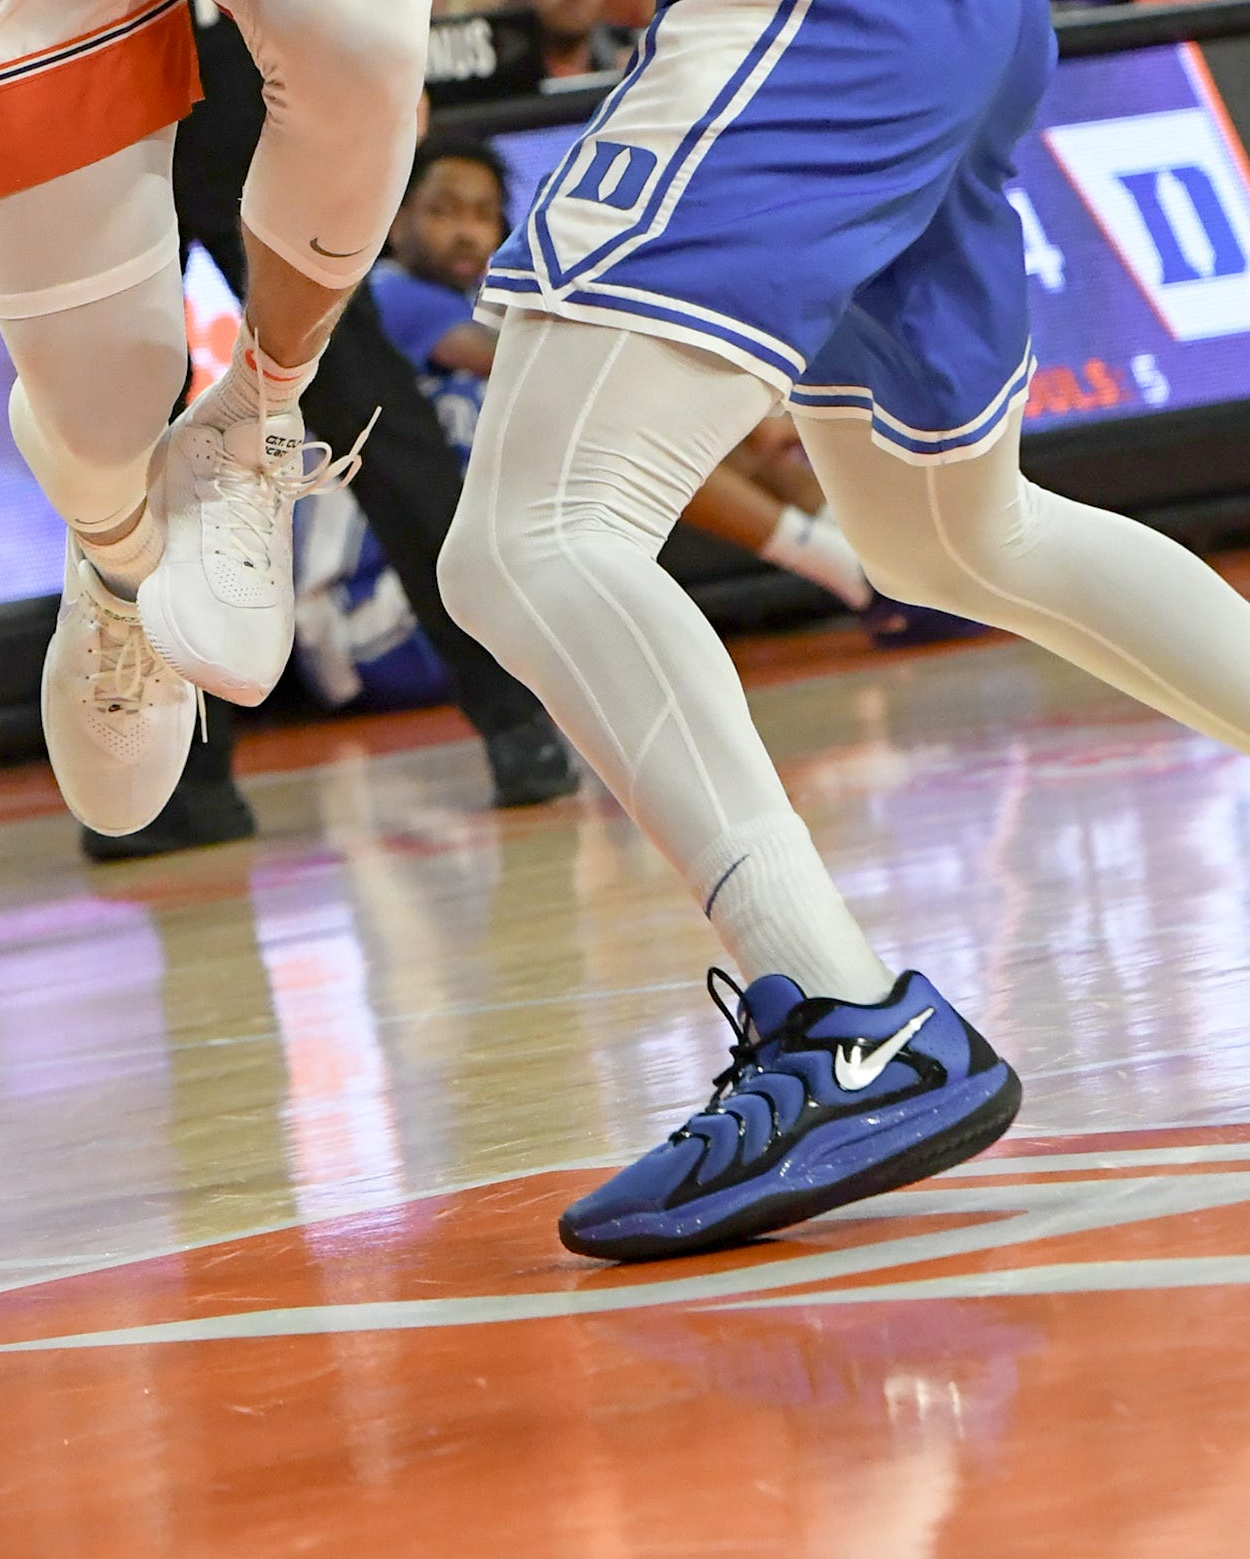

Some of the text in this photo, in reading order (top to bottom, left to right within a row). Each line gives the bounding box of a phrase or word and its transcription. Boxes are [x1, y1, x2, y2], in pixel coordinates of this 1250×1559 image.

[424, 18, 496, 83] NUS
[565, 140, 657, 211] D
[1109, 165, 1246, 285] D
